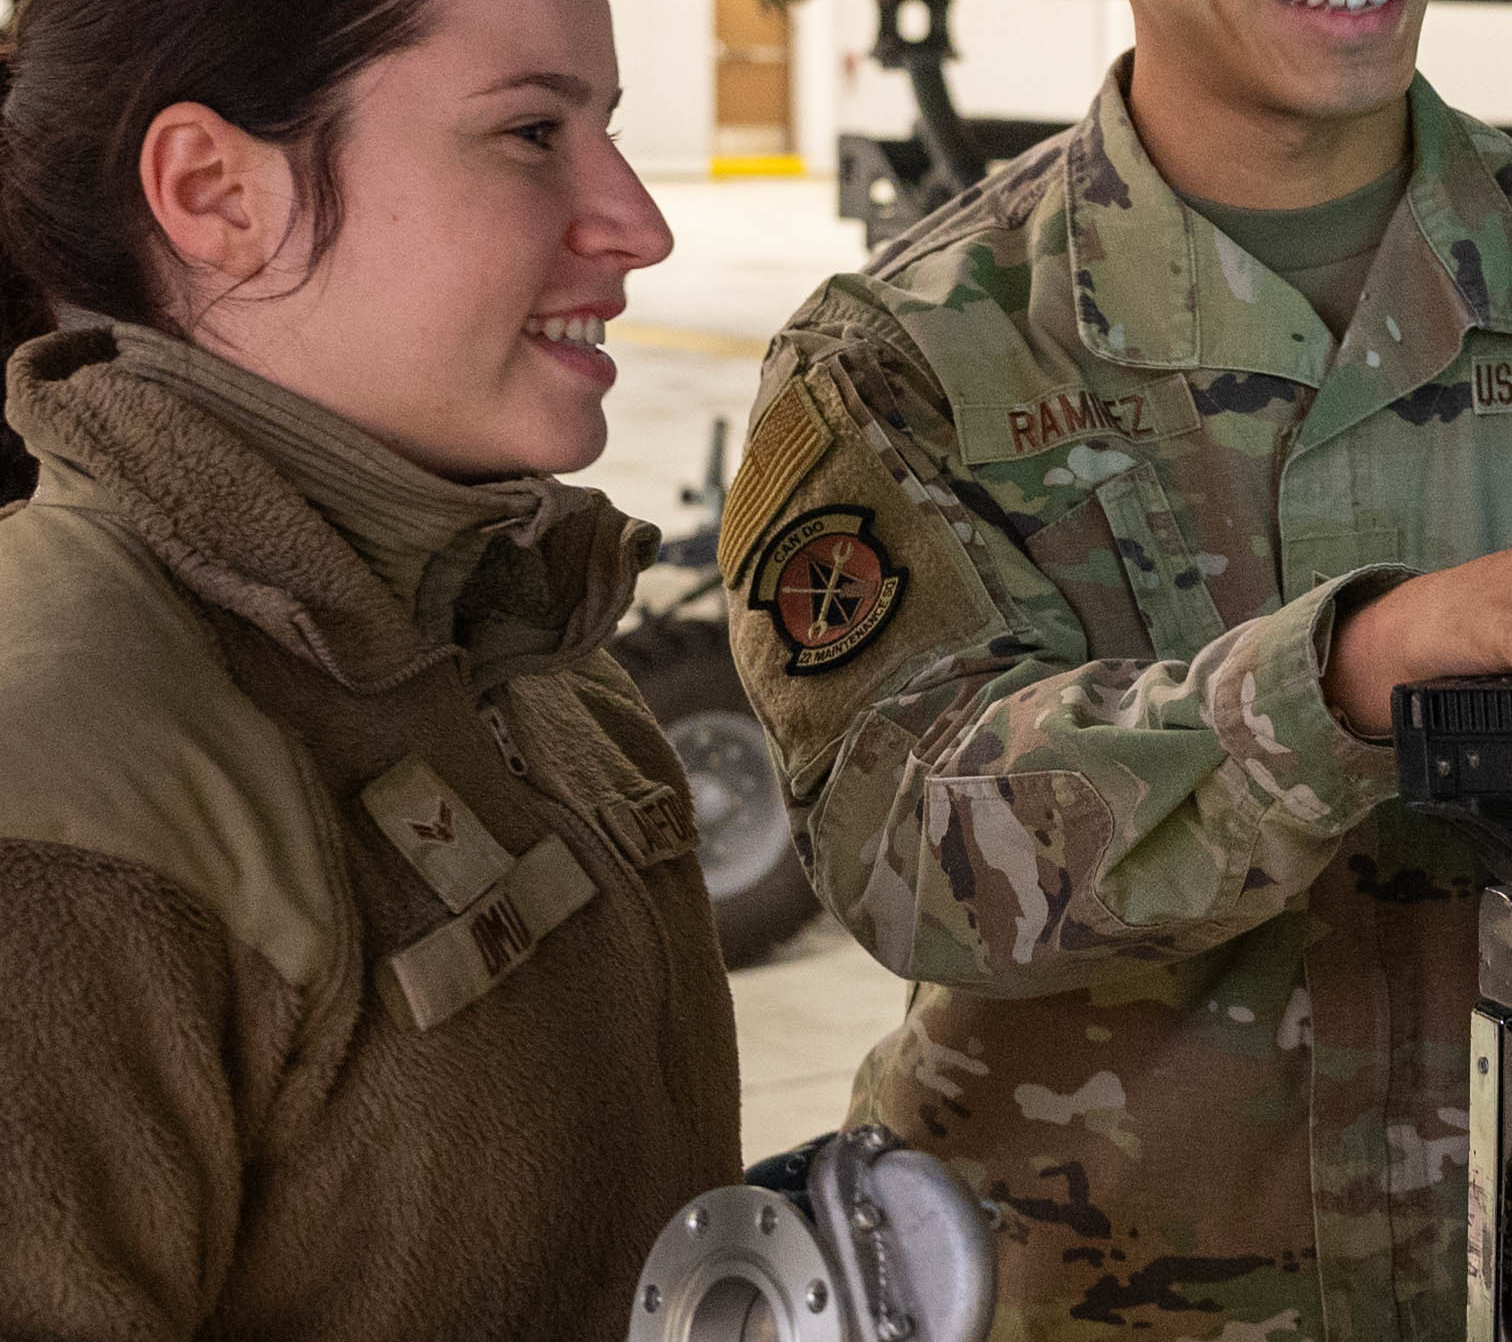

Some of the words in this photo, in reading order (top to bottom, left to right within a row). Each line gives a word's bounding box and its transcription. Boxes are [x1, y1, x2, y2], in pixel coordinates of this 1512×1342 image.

[774, 534, 804, 564] CAN
[802, 520, 825, 538] DO
[814, 599, 890, 662] MAINTENANCE
